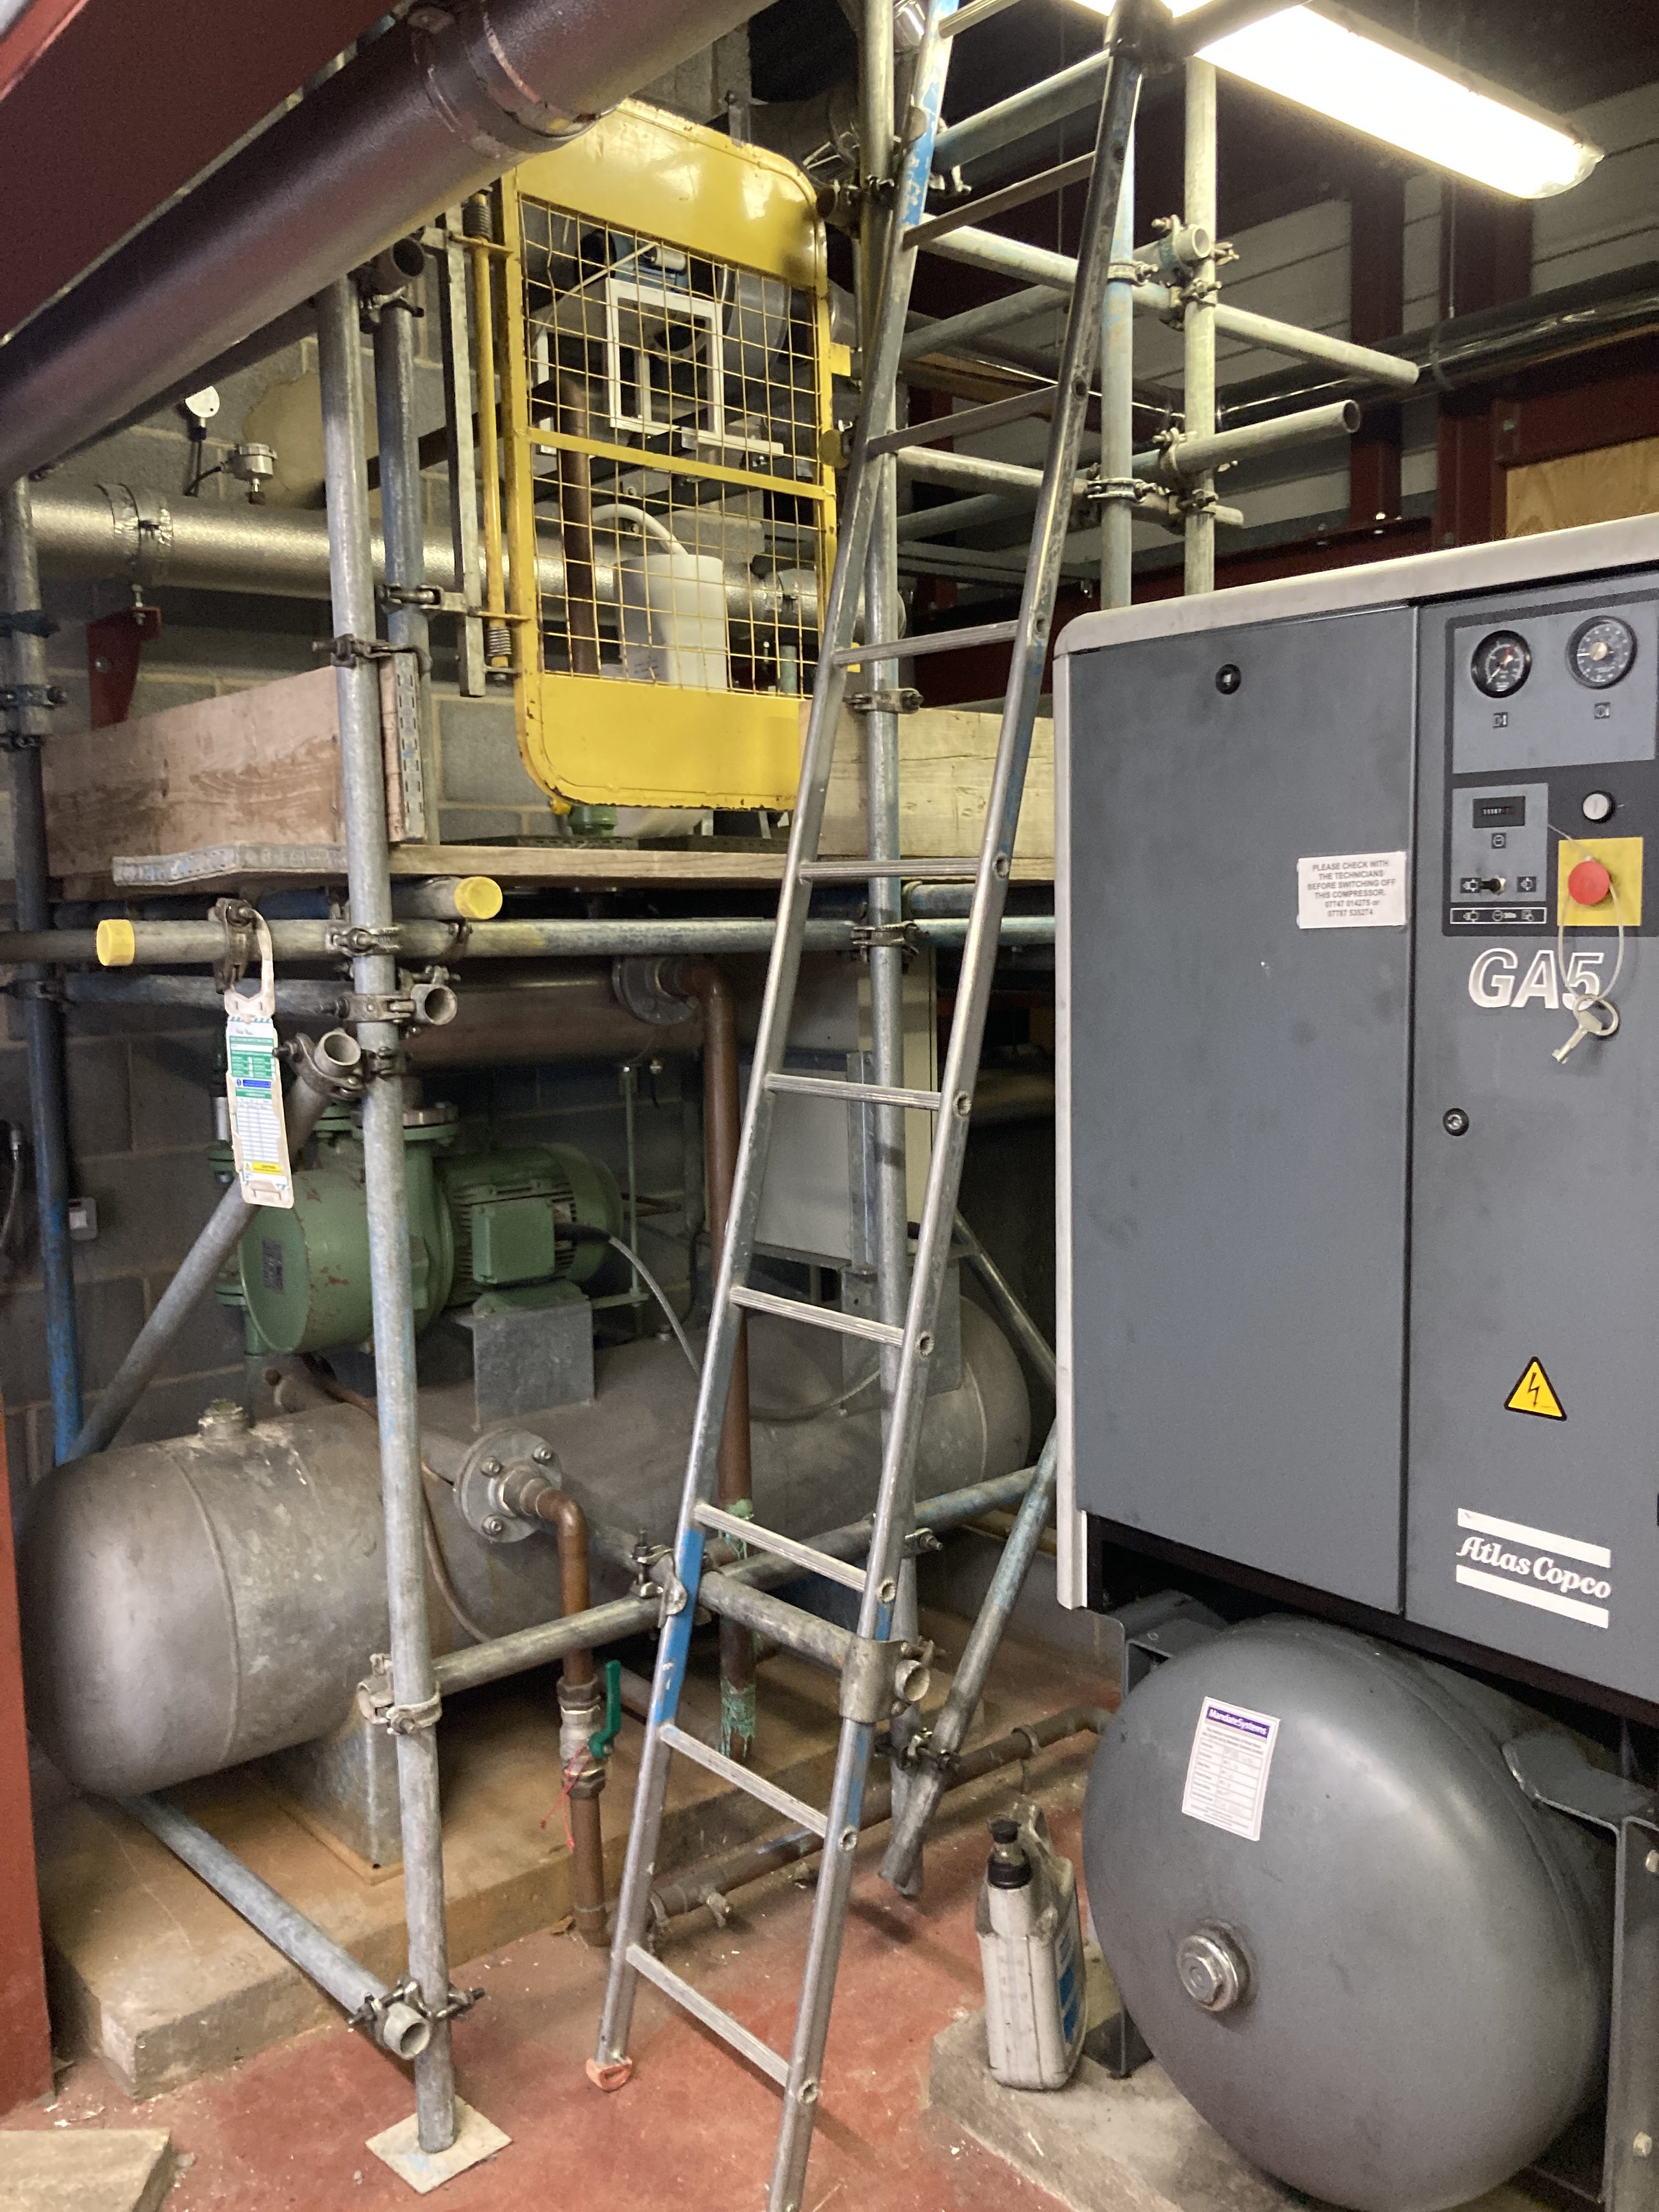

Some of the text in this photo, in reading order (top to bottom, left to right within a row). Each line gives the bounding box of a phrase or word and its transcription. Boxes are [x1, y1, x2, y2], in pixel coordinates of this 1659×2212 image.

[1312, 862, 1340, 871] PLEASE
[1342, 861, 1368, 869] CHECK
[1319, 870, 1384, 881] THE TECHNICIANS
[1307, 878, 1396, 890] BEFORE SWITCHING OFF
[1314, 889, 1386, 900] THIS COMPRESSOR.
[1468, 947, 1604, 1011] GA5
[1455, 1536, 1612, 1599] Atlas Copco
